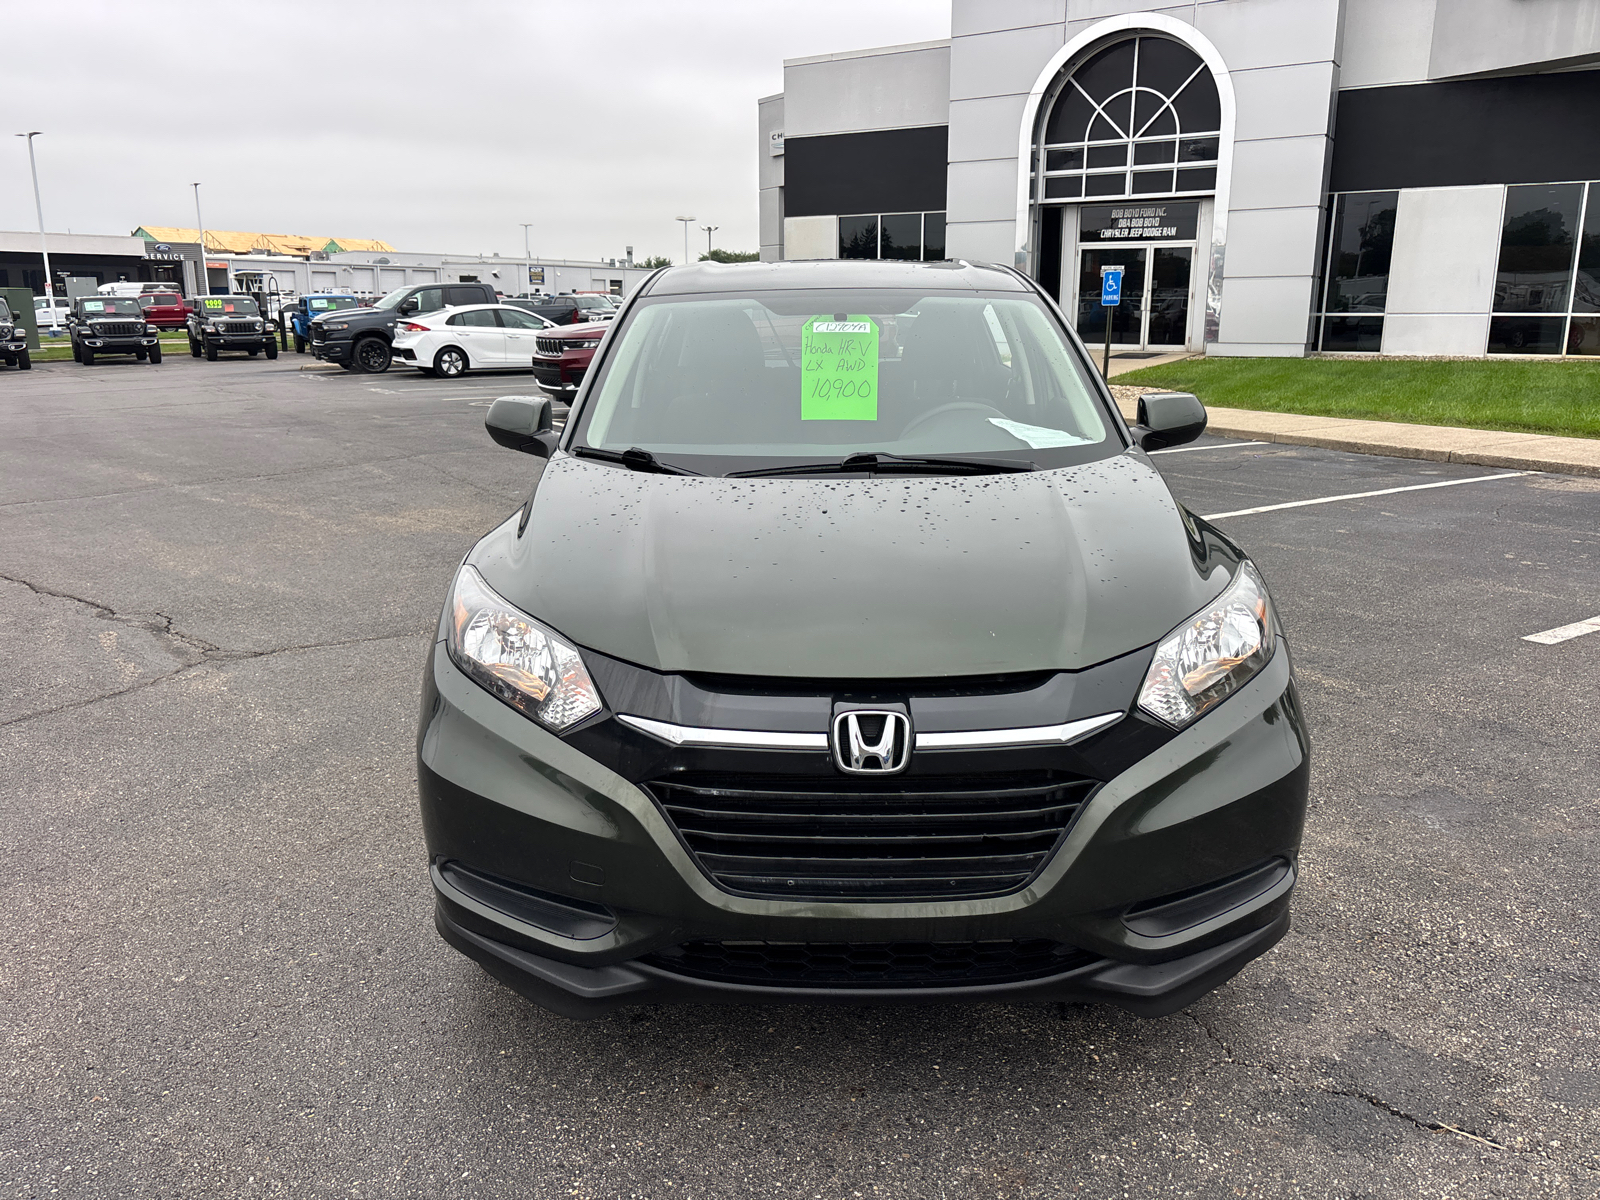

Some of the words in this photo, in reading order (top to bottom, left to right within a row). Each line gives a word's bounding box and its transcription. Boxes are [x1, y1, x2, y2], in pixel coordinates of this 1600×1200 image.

[1111, 209, 1124, 218] BOB
[1124, 208, 1140, 218] BOYD
[1140, 207, 1156, 217] FORD
[1156, 207, 1167, 217] INC.
[1131, 218, 1144, 227] BOB
[1144, 217, 1160, 226] BOYD
[1100, 228, 1129, 238] CHRYSLER
[1129, 228, 1143, 237] JEEP
[1143, 227, 1163, 237] DODGE
[1162, 226, 1177, 236] RAM
[144, 253, 185, 261] SERVICE
[805, 335, 834, 355] Honda
[838, 339, 872, 356] HR-V
[805, 359, 824, 372] LX
[835, 357, 866, 372] AWD
[811, 377, 872, 402] 10,900
